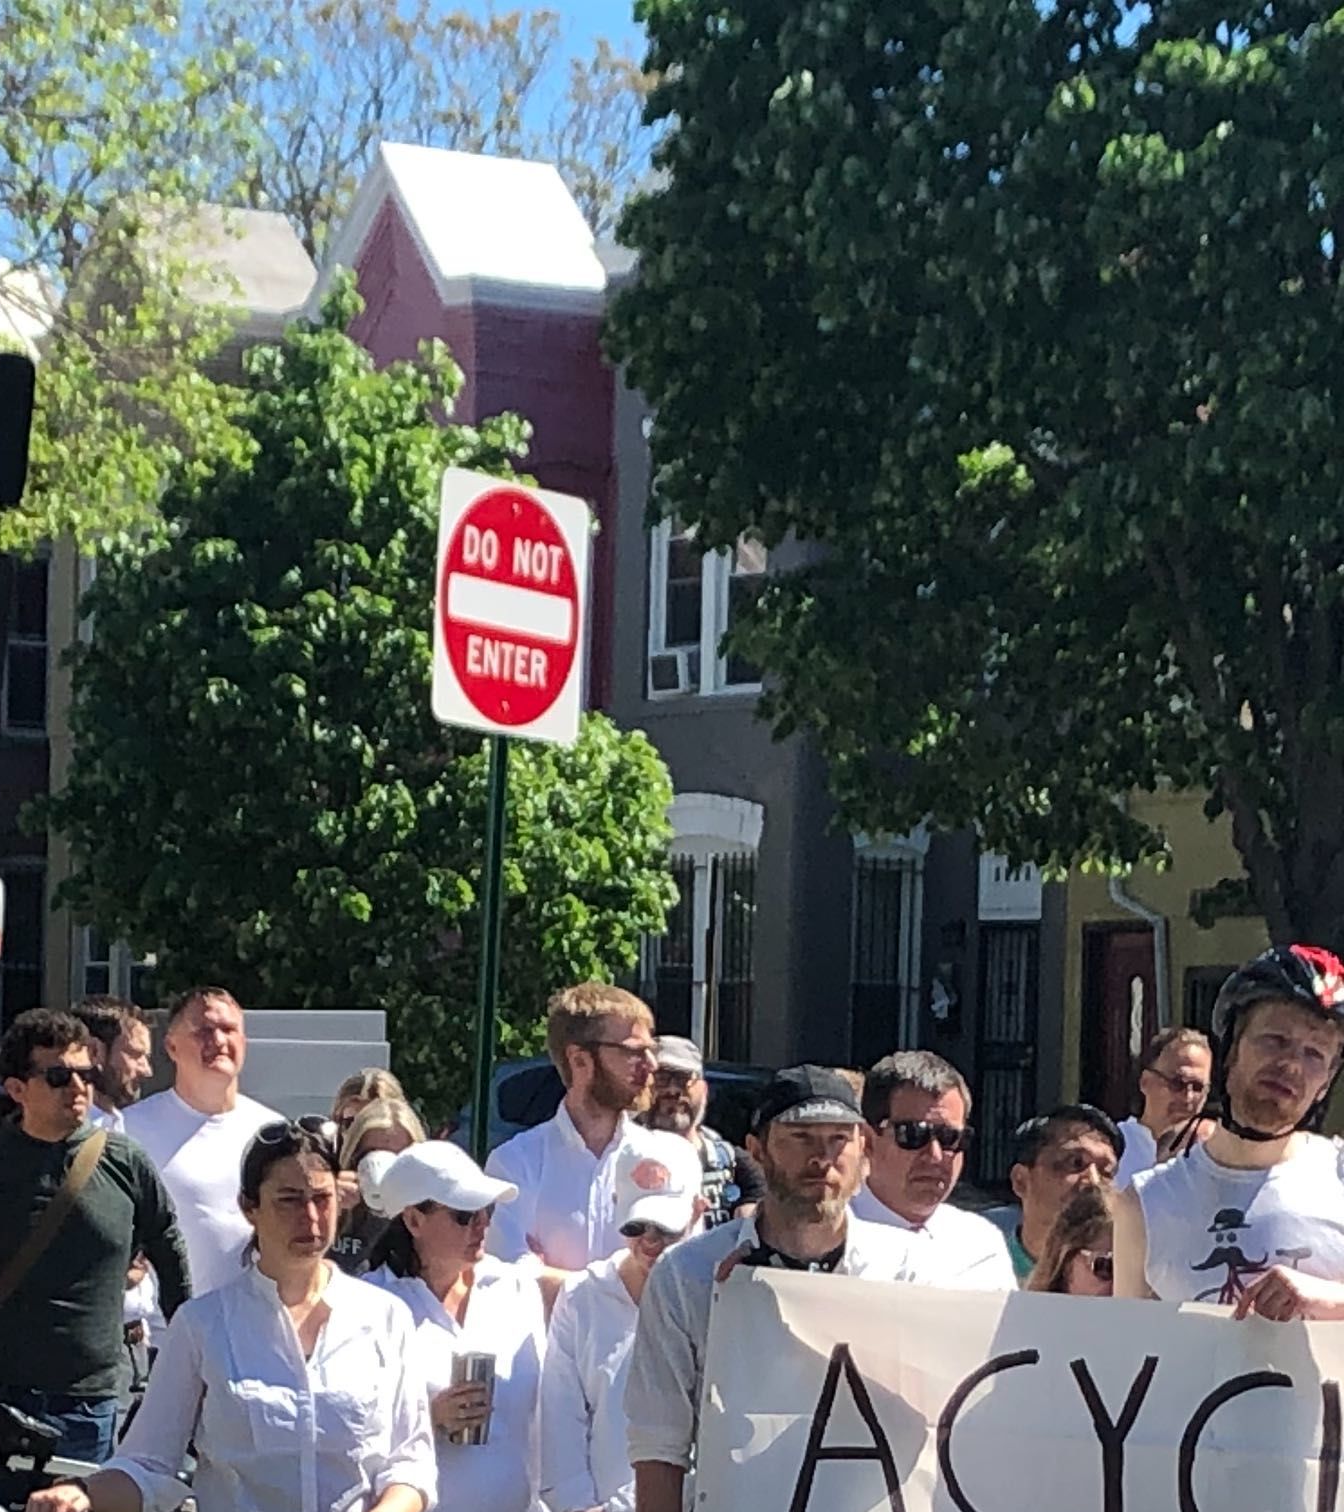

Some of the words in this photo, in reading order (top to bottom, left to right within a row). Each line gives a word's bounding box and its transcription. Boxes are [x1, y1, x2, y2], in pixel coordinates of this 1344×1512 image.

[462, 523, 500, 571] DO
[511, 536, 564, 585] NOT
[466, 634, 548, 688] ENTER
